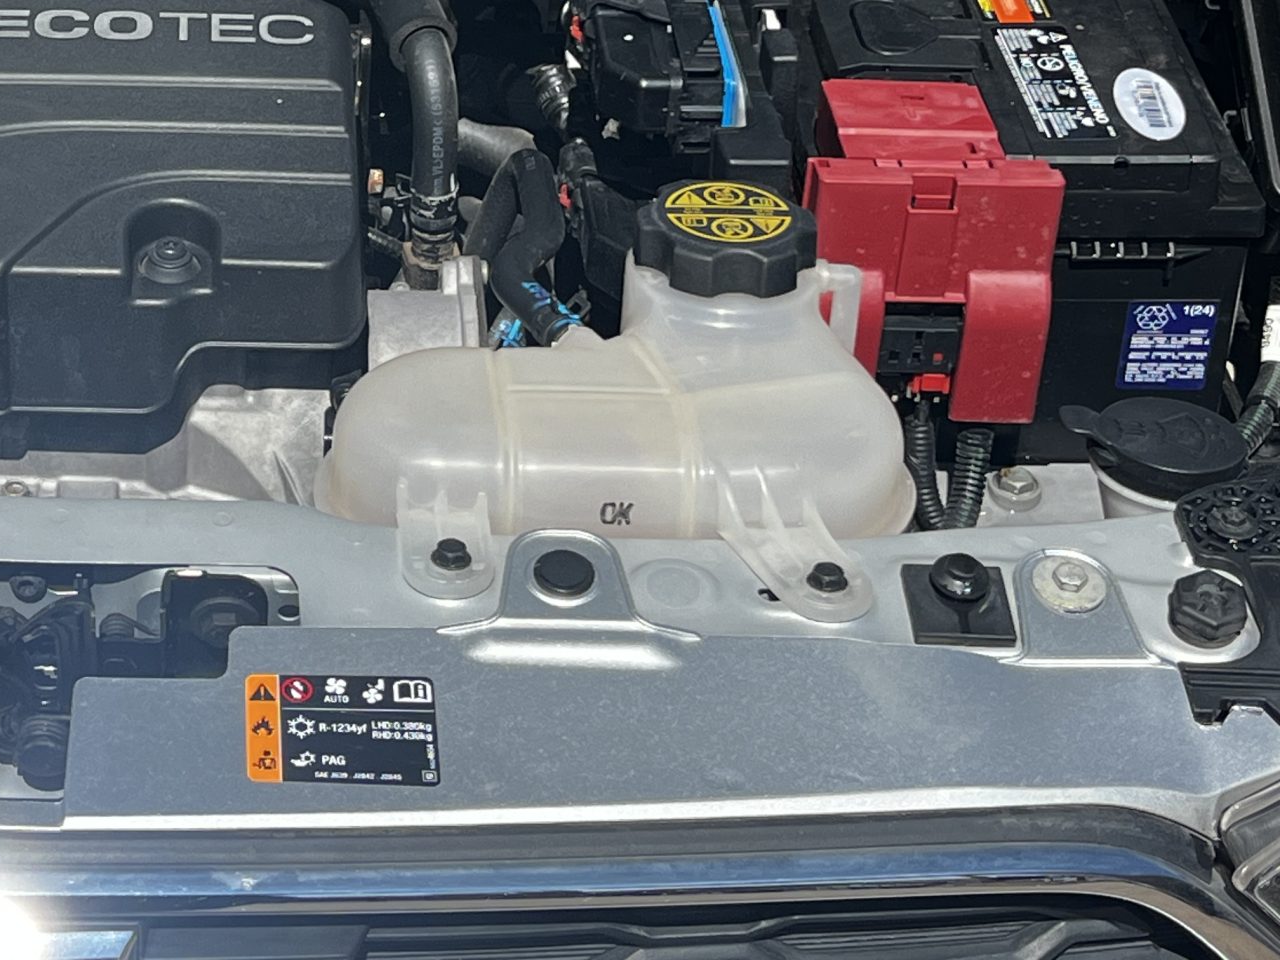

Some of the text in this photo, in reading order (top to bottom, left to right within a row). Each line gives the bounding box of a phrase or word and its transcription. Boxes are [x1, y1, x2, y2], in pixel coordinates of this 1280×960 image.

[1183, 304, 1215, 317] 1(24)
[599, 501, 634, 525] OK
[323, 694, 350, 704] AUTO
[318, 722, 368, 735] R-1234yf
[321, 754, 347, 766] PAG
